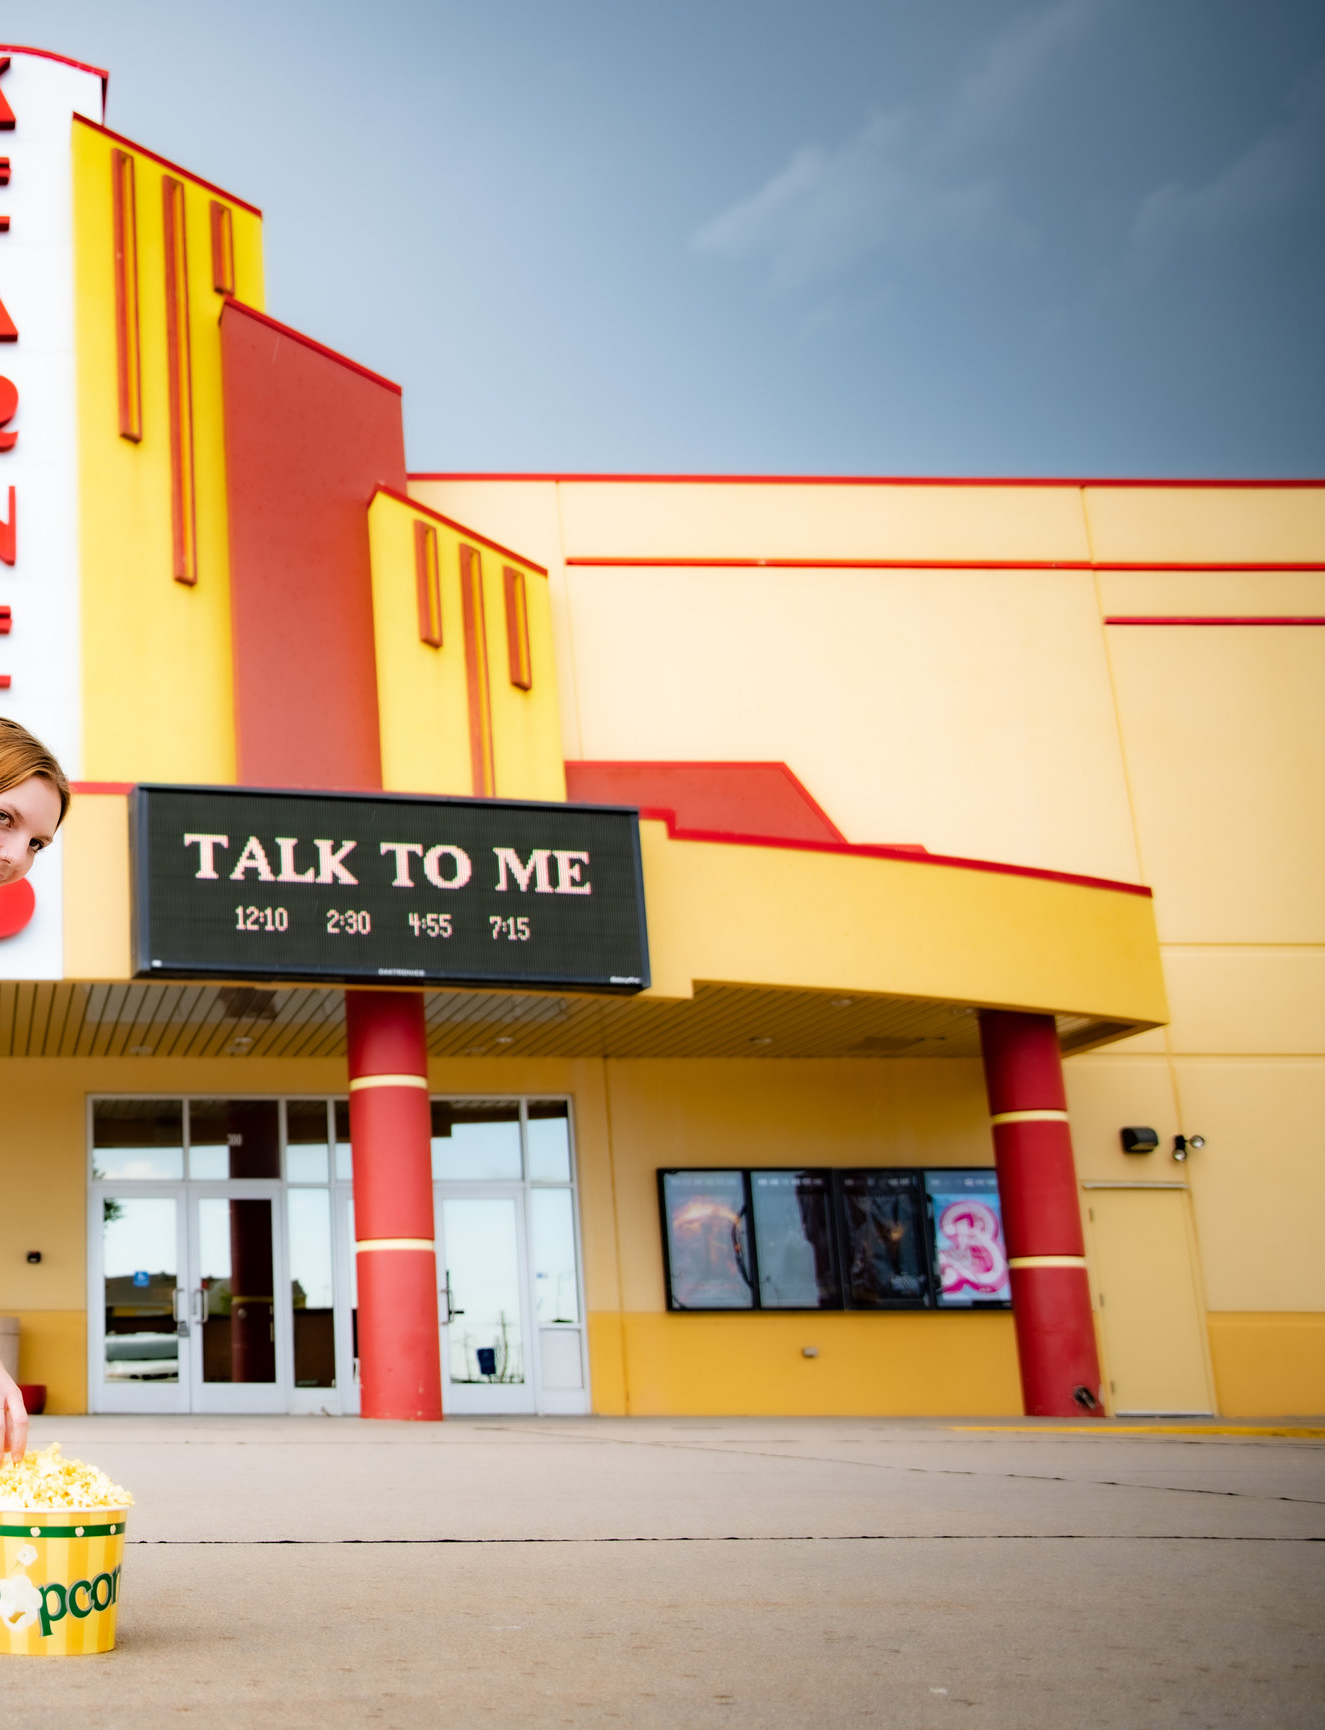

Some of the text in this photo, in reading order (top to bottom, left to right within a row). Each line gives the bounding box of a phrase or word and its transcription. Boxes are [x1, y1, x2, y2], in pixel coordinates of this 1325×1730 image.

[183, 832, 592, 896] TALK TO ME
[235, 905, 531, 941] 12:10 2:30 4:55 7:15
